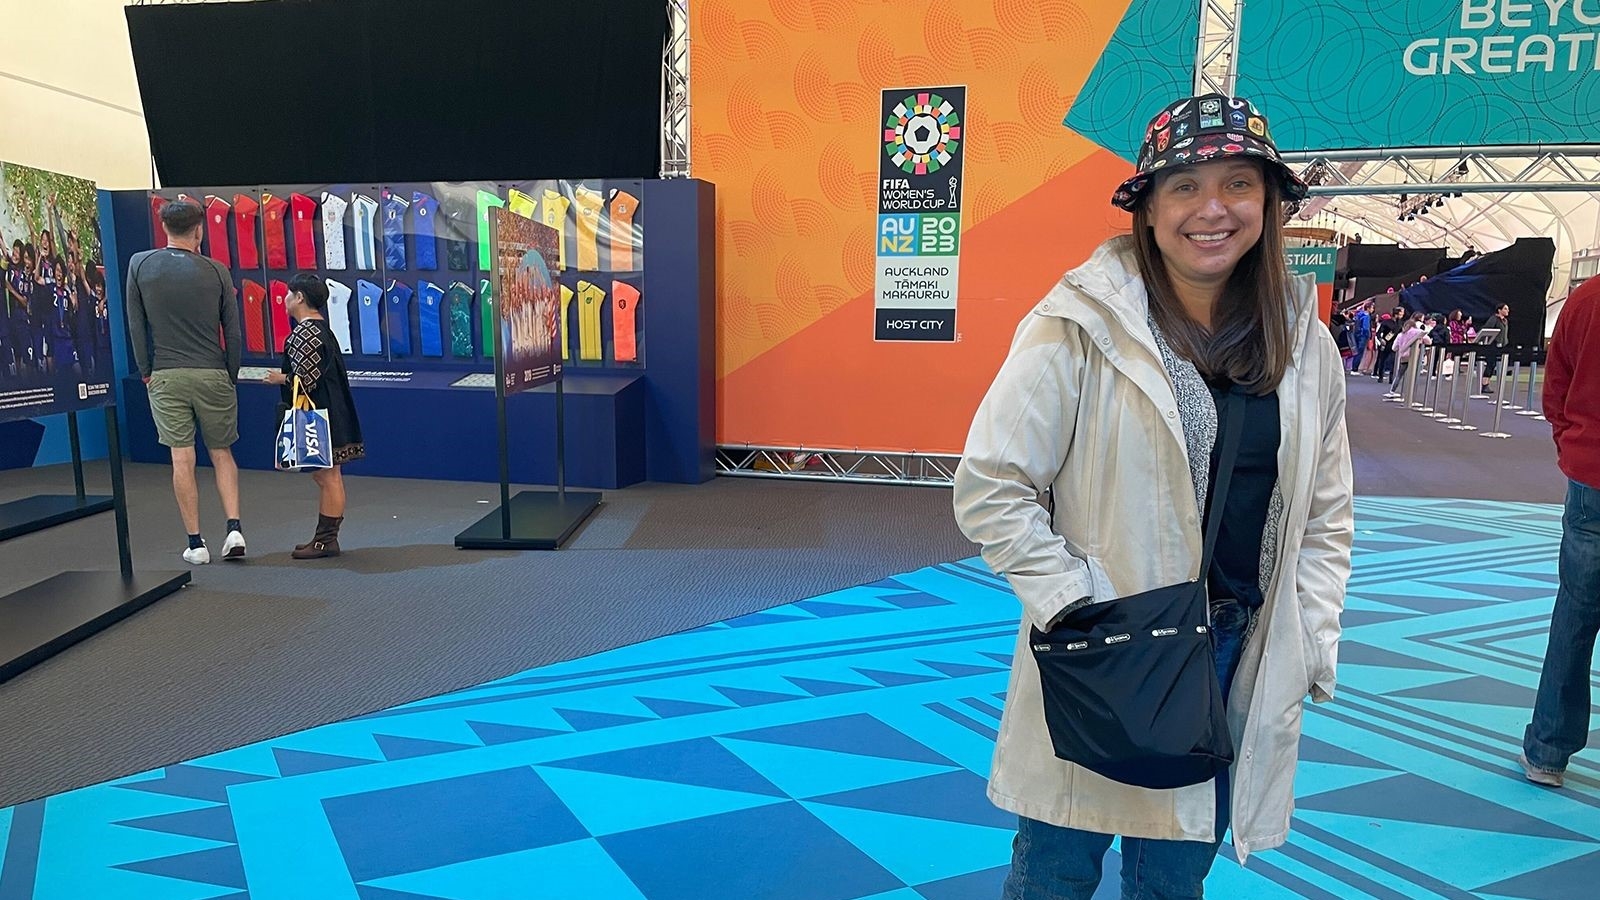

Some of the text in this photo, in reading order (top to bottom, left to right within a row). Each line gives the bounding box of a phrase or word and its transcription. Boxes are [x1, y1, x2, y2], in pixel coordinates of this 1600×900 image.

[1403, 33, 1600, 76] GREAT
[883, 179, 910, 190] FIFA
[883, 189, 935, 199] WOMEN'S
[882, 199, 945, 209] WORLD CUP
[882, 218, 915, 235] AU
[922, 217, 956, 234] 20
[881, 235, 914, 252] NZ
[921, 235, 955, 252] 23
[885, 267, 949, 276] AUCKLAND
[895, 279, 938, 289] TĀMAKI
[883, 290, 950, 299] MAKAURAU
[886, 320, 944, 330] HOST CITY
[305, 419, 320, 456] VISA
